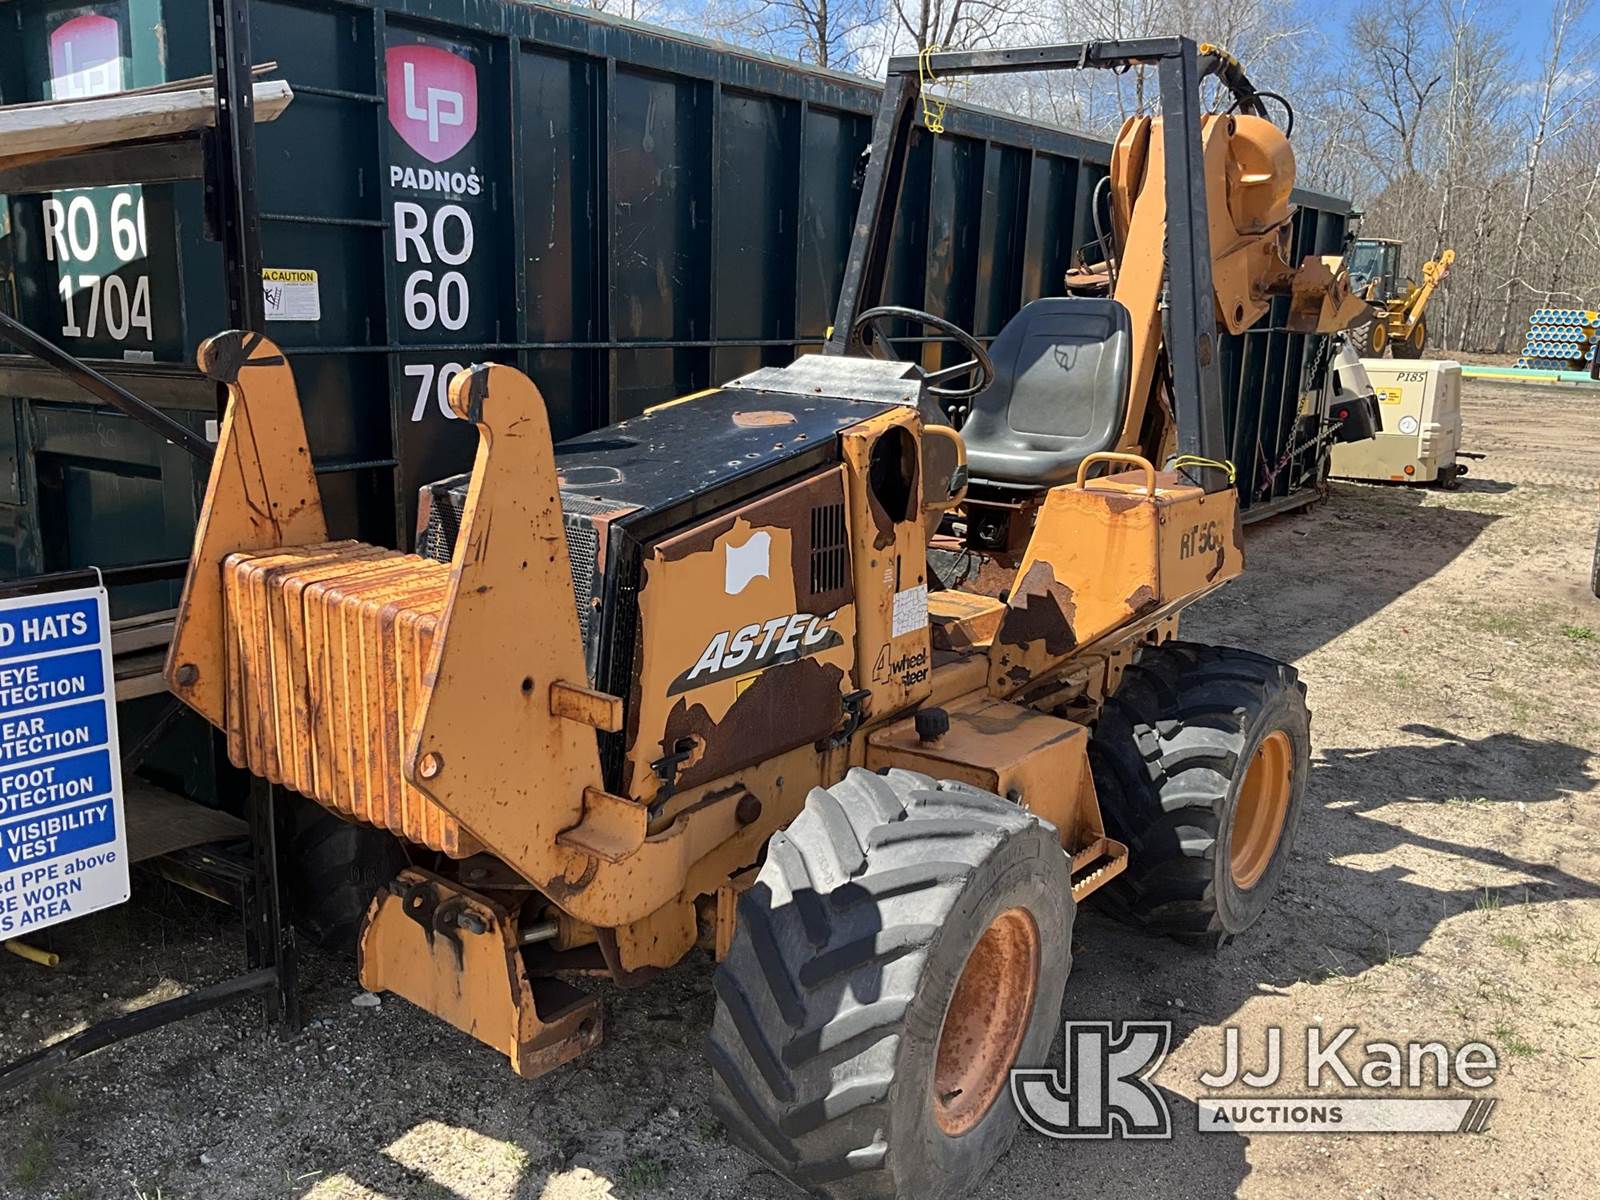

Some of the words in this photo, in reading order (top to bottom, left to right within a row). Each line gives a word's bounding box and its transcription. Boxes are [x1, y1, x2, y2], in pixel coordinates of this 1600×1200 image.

[404, 62, 464, 142] LP
[389, 165, 481, 195] PADNOS
[42, 195, 98, 262] RO
[394, 202, 474, 265] RO
[271, 271, 314, 282] CAUTION
[59, 274, 153, 341] 1704
[404, 270, 469, 331] 60
[1396, 371, 1424, 383] P185
[22, 611, 88, 643] HATS
[687, 610, 838, 680] ASTEC
[892, 647, 926, 674] wheel
[0, 665, 39, 687] EYE
[0, 726, 89, 760] TECTION
[2, 717, 45, 740] EAR
[2, 766, 55, 795] FOOT
[7, 804, 107, 845] VISIBILITY
[7, 836, 58, 863] VEST
[22, 864, 59, 887] PPE
[64, 851, 116, 875] above
[23, 877, 82, 907] WORN
[20, 898, 71, 927] AREA
